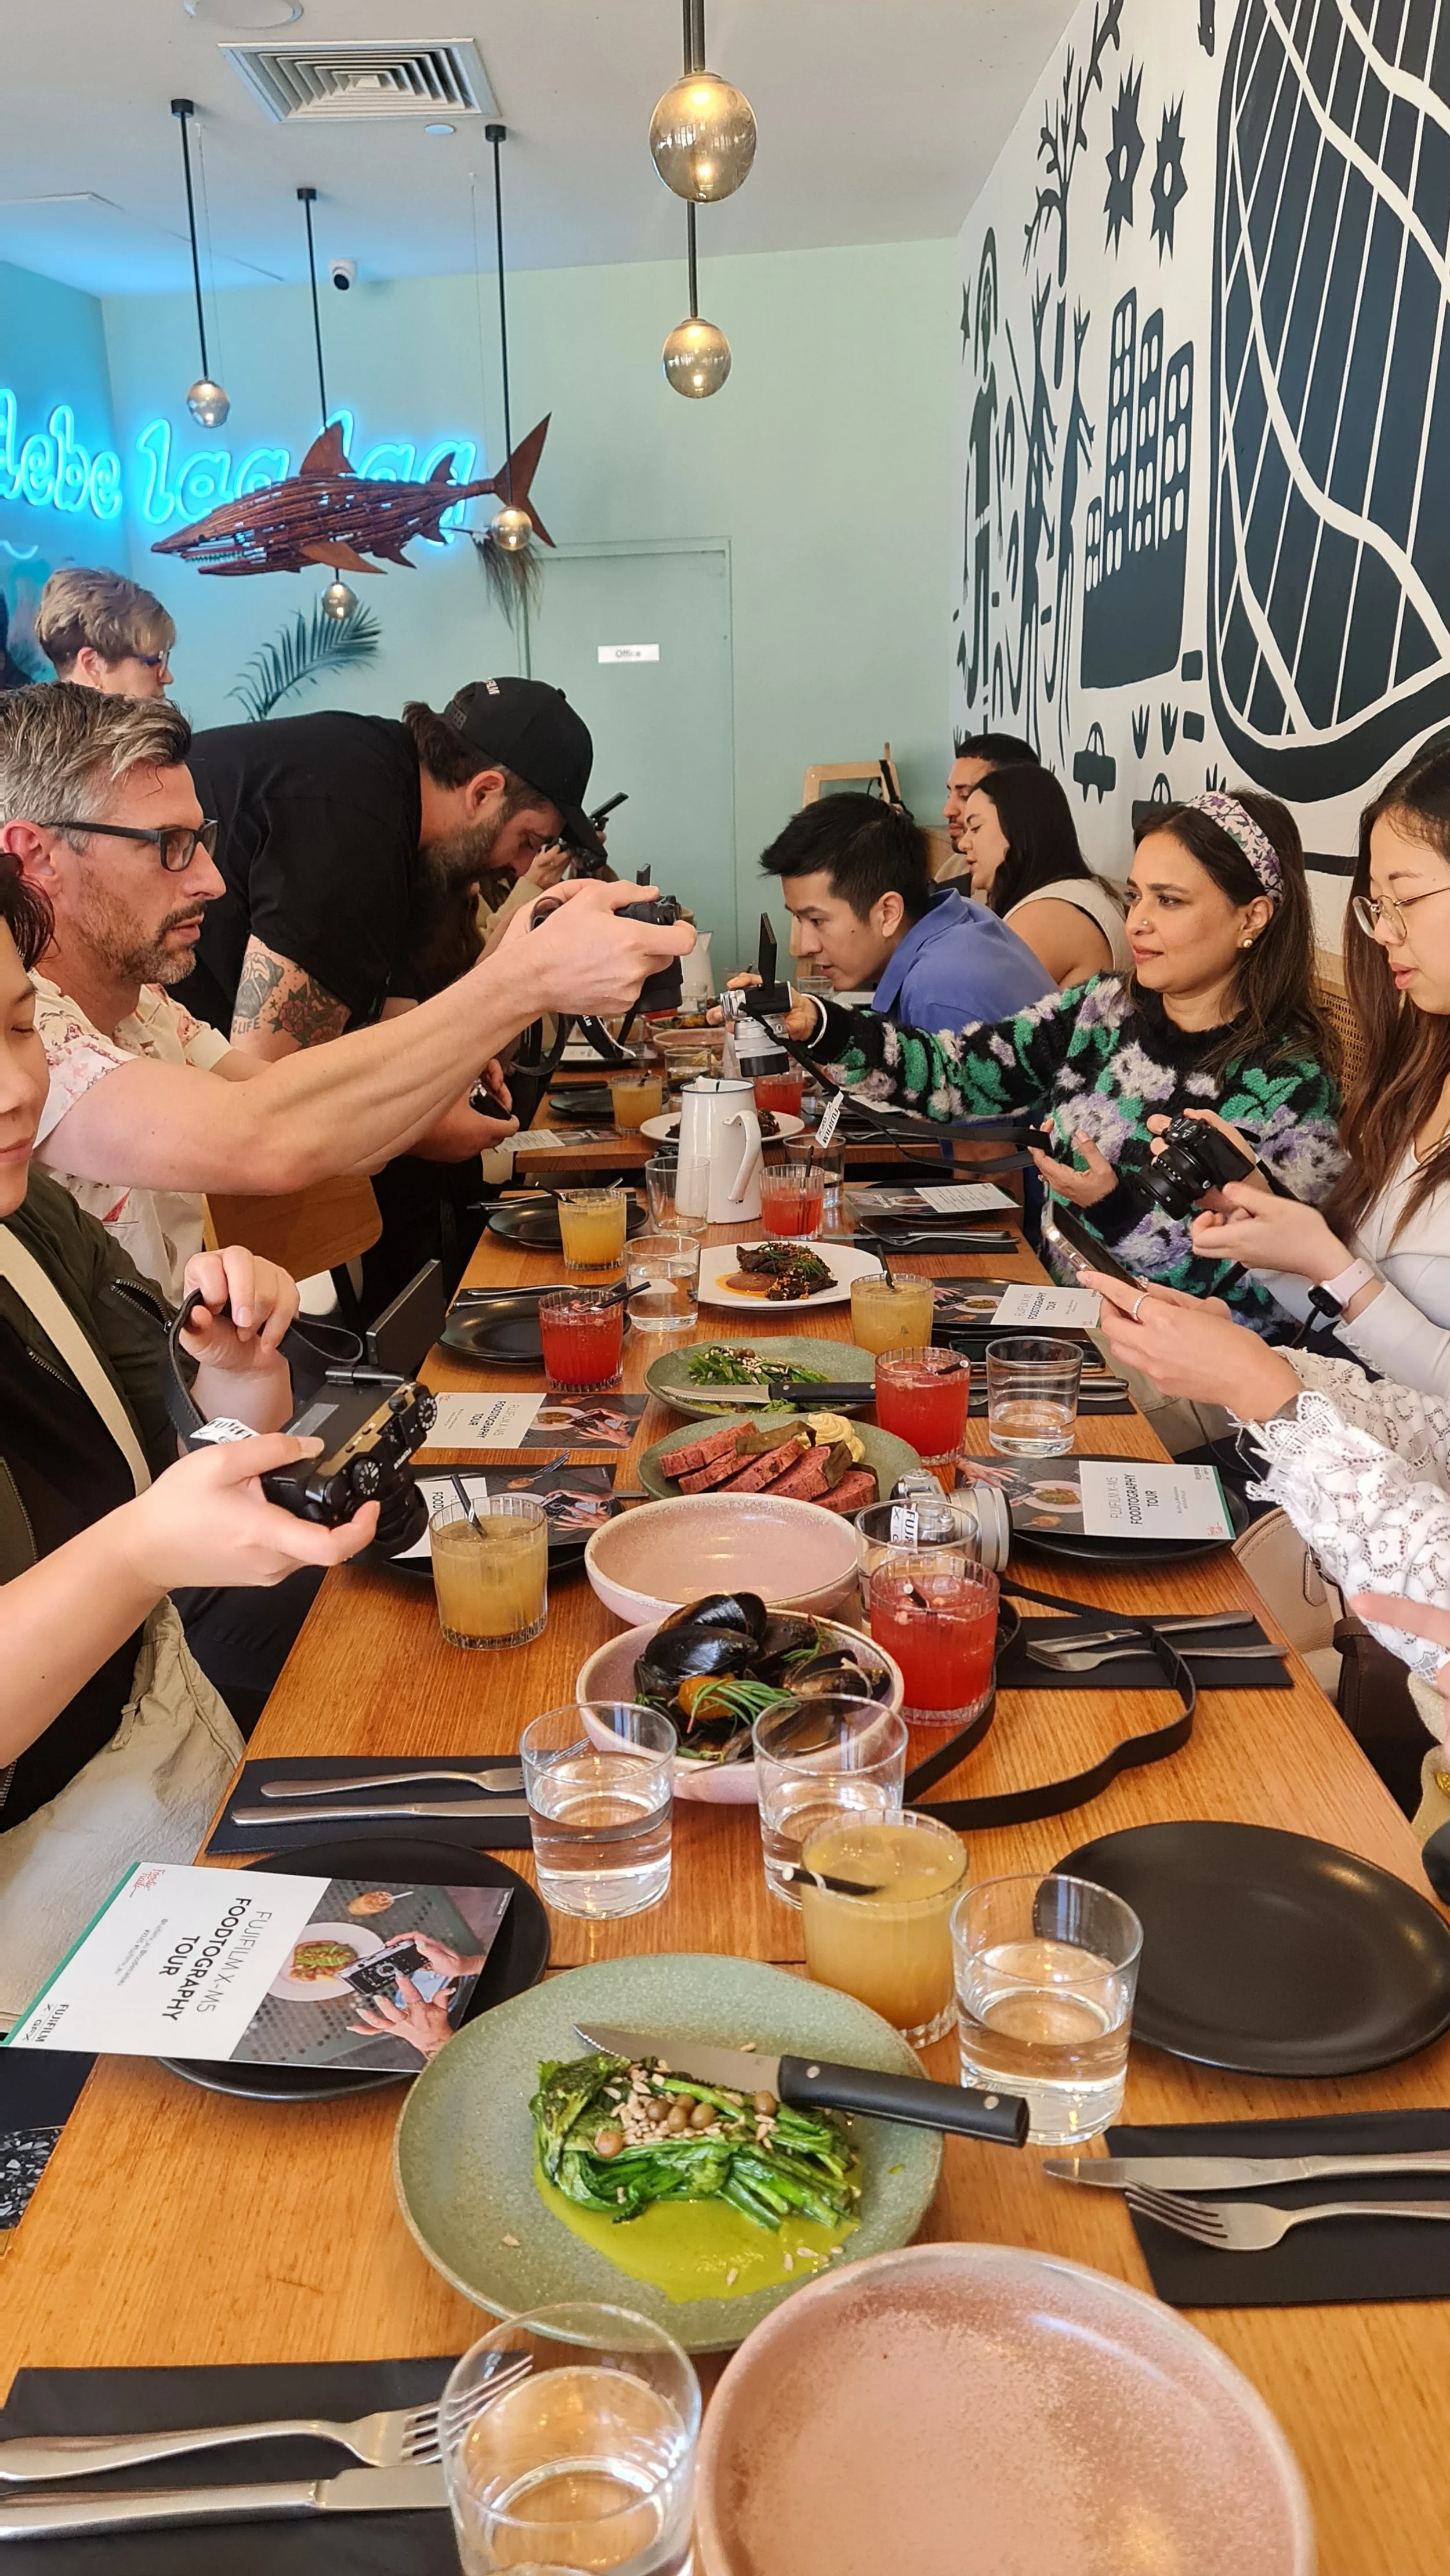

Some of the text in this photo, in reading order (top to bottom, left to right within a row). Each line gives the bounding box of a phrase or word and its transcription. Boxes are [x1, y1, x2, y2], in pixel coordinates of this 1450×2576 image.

[615, 649, 641, 658] Office
[237, 1016, 261, 1034] LIFE
[822, 1108, 839, 1144] FUJIFILM
[207, 1420, 253, 1439] FUJIFI
[1124, 1474, 1143, 1524] FOODTOGRAPHY
[1145, 1490, 1159, 1507] TOUR
[157, 1935, 201, 1976] TOUR
[158, 1897, 253, 2021] FOODTOGRAPHY
[194, 1911, 273, 2013] FUJIFILM X-M5
[21, 2019, 43, 2041] GFX
[32, 2003, 71, 2042] FUJIFILM
